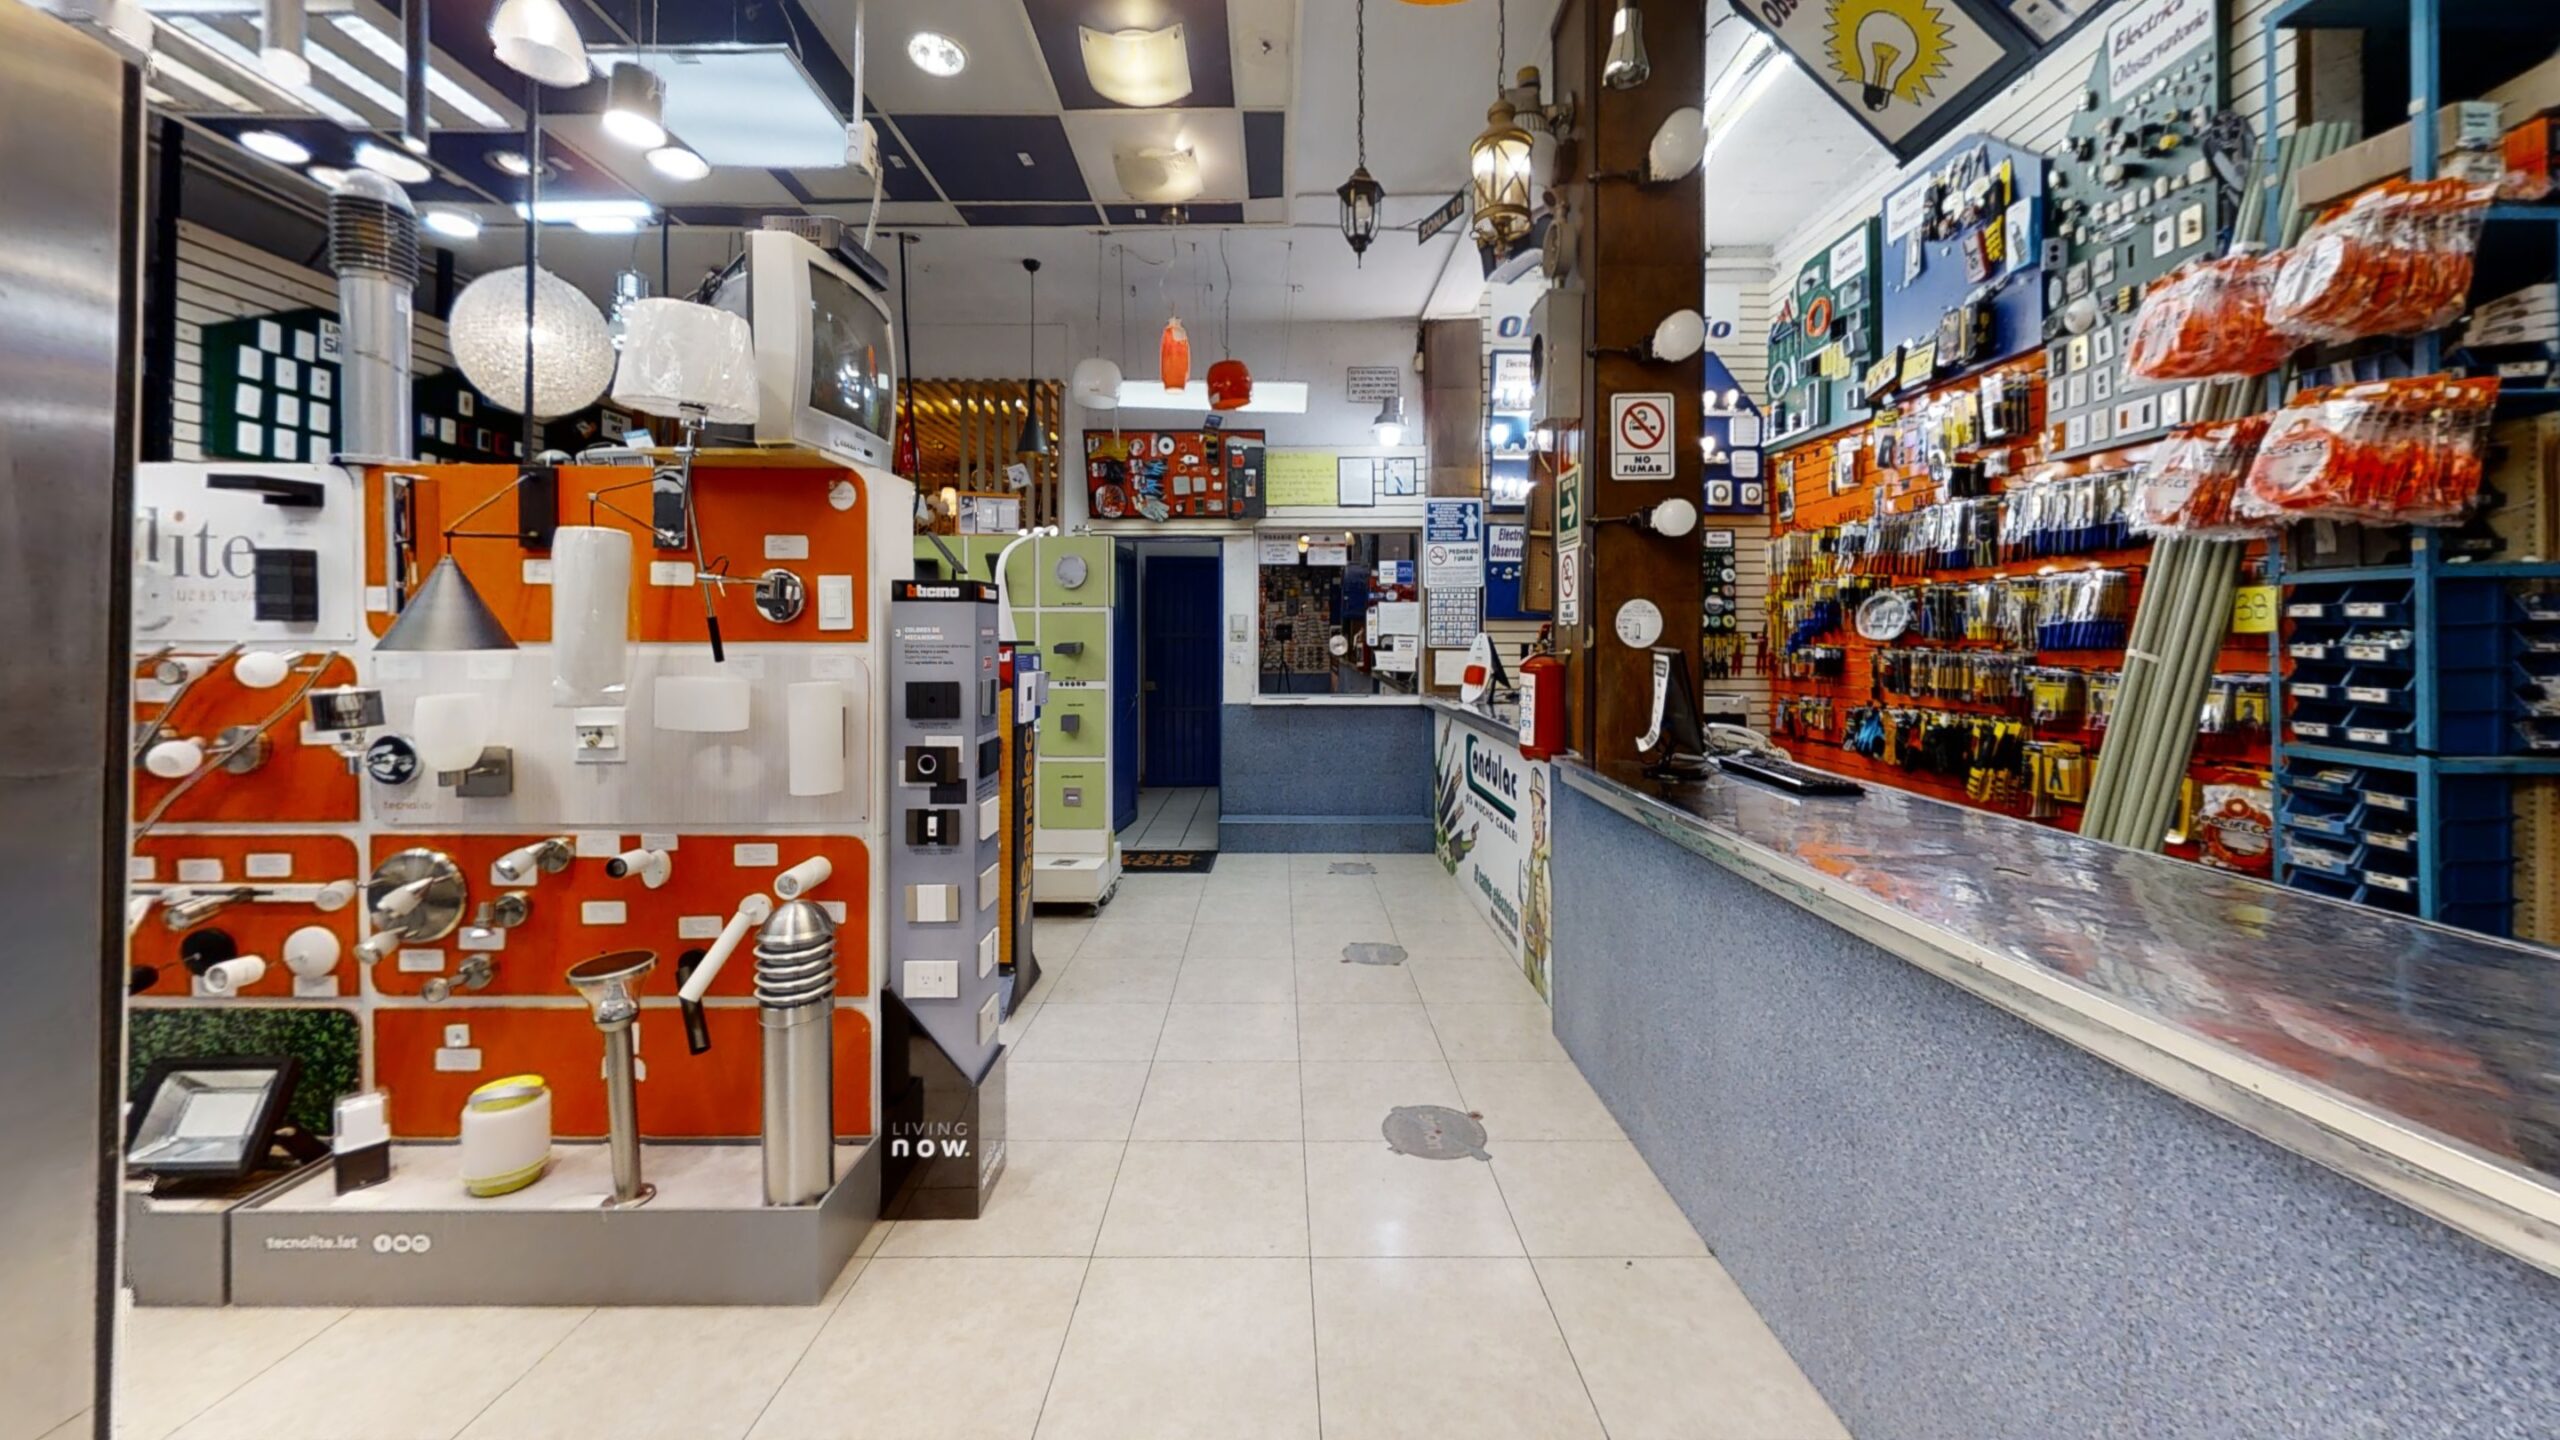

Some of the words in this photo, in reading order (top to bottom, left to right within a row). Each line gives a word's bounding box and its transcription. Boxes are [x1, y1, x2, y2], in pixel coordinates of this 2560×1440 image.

[1634, 455, 1652, 464] NO
[1623, 464, 1662, 473] FUMAR
[892, 1121, 968, 1136] LIVING
[891, 1138, 970, 1158] now.
